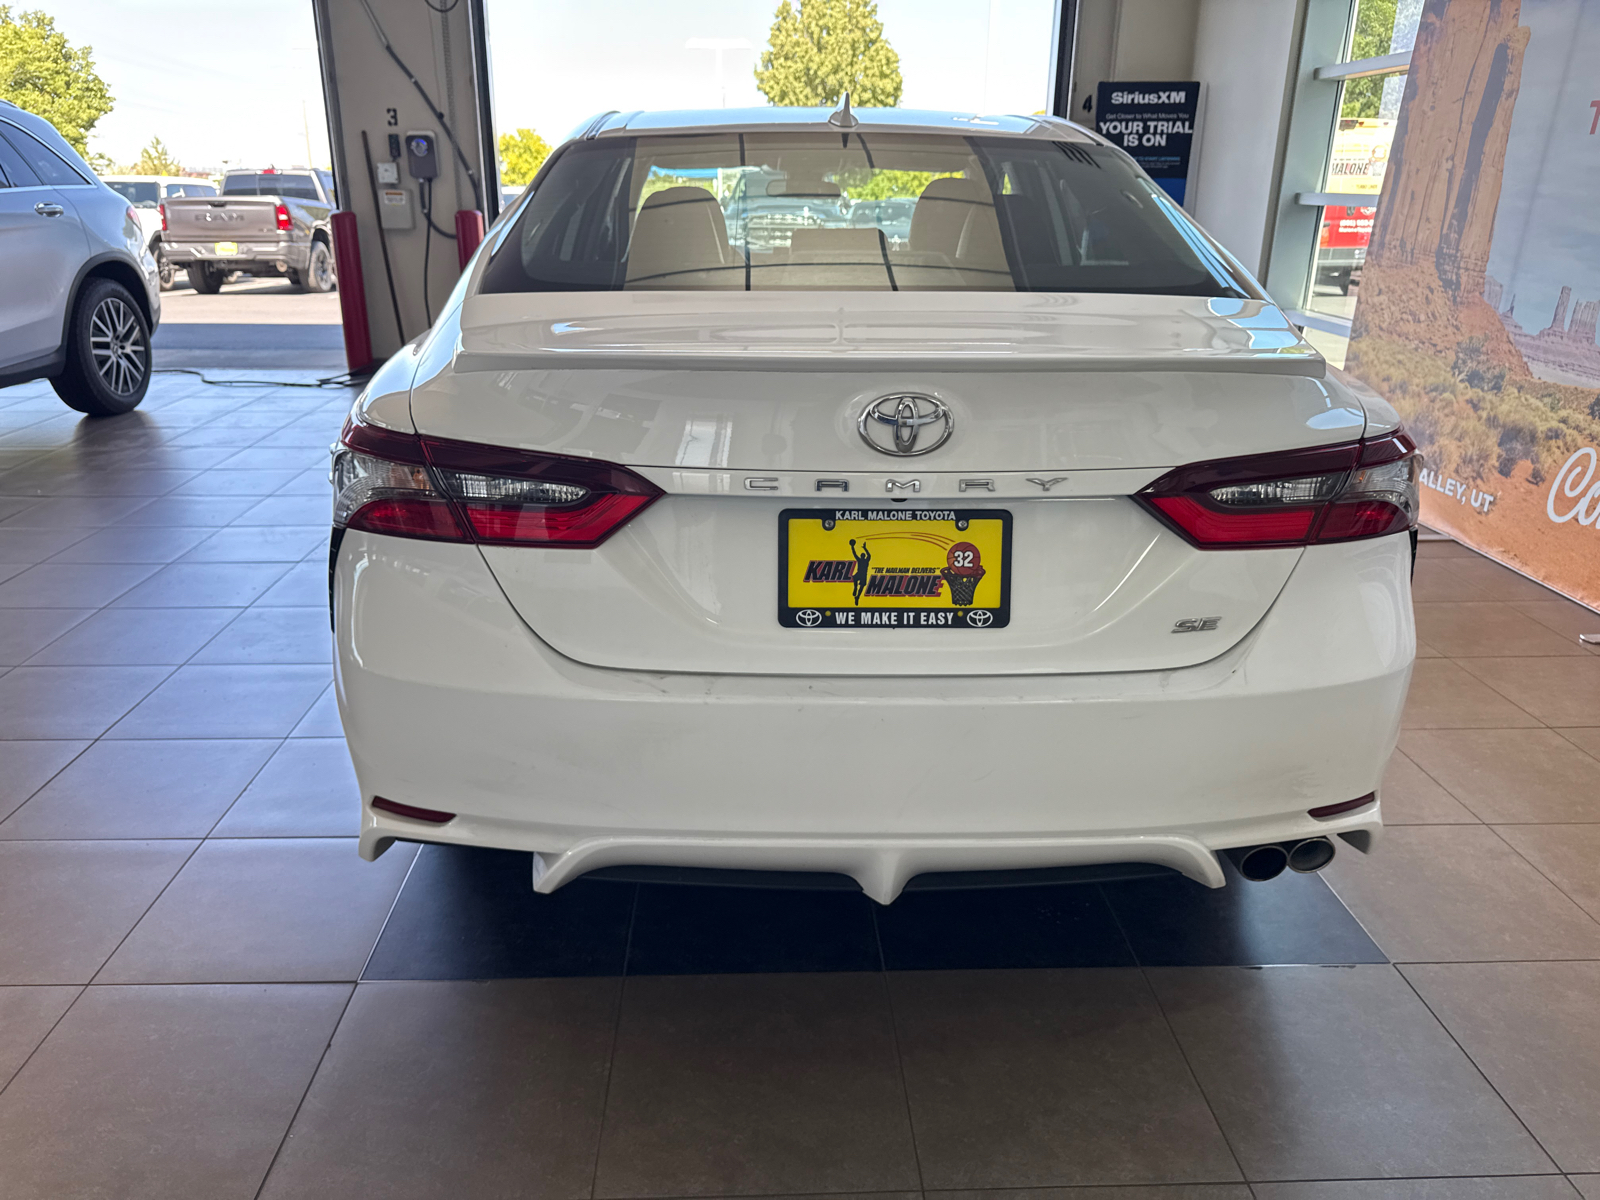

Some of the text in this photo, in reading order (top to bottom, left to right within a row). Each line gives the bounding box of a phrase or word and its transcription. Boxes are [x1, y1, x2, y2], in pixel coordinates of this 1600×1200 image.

[1082, 94, 1093, 113] 4
[1111, 91, 1186, 105] SiriusXM
[386, 107, 398, 127] 3
[1178, 112, 1189, 120] You
[1099, 121, 1193, 134] YOUR TRIAL
[1123, 134, 1167, 147] IS ON
[744, 476, 1068, 493] CAMRY
[1546, 446, 1600, 530] Ca
[1470, 488, 1494, 512] UT
[835, 511, 956, 520] KARL MALONE TOYOTA
[953, 550, 974, 567] 32
[803, 560, 857, 582] KARL
[864, 575, 944, 597] MALONE
[835, 612, 954, 625] WE MAKE IT EASY
[1171, 616, 1222, 634] SE
